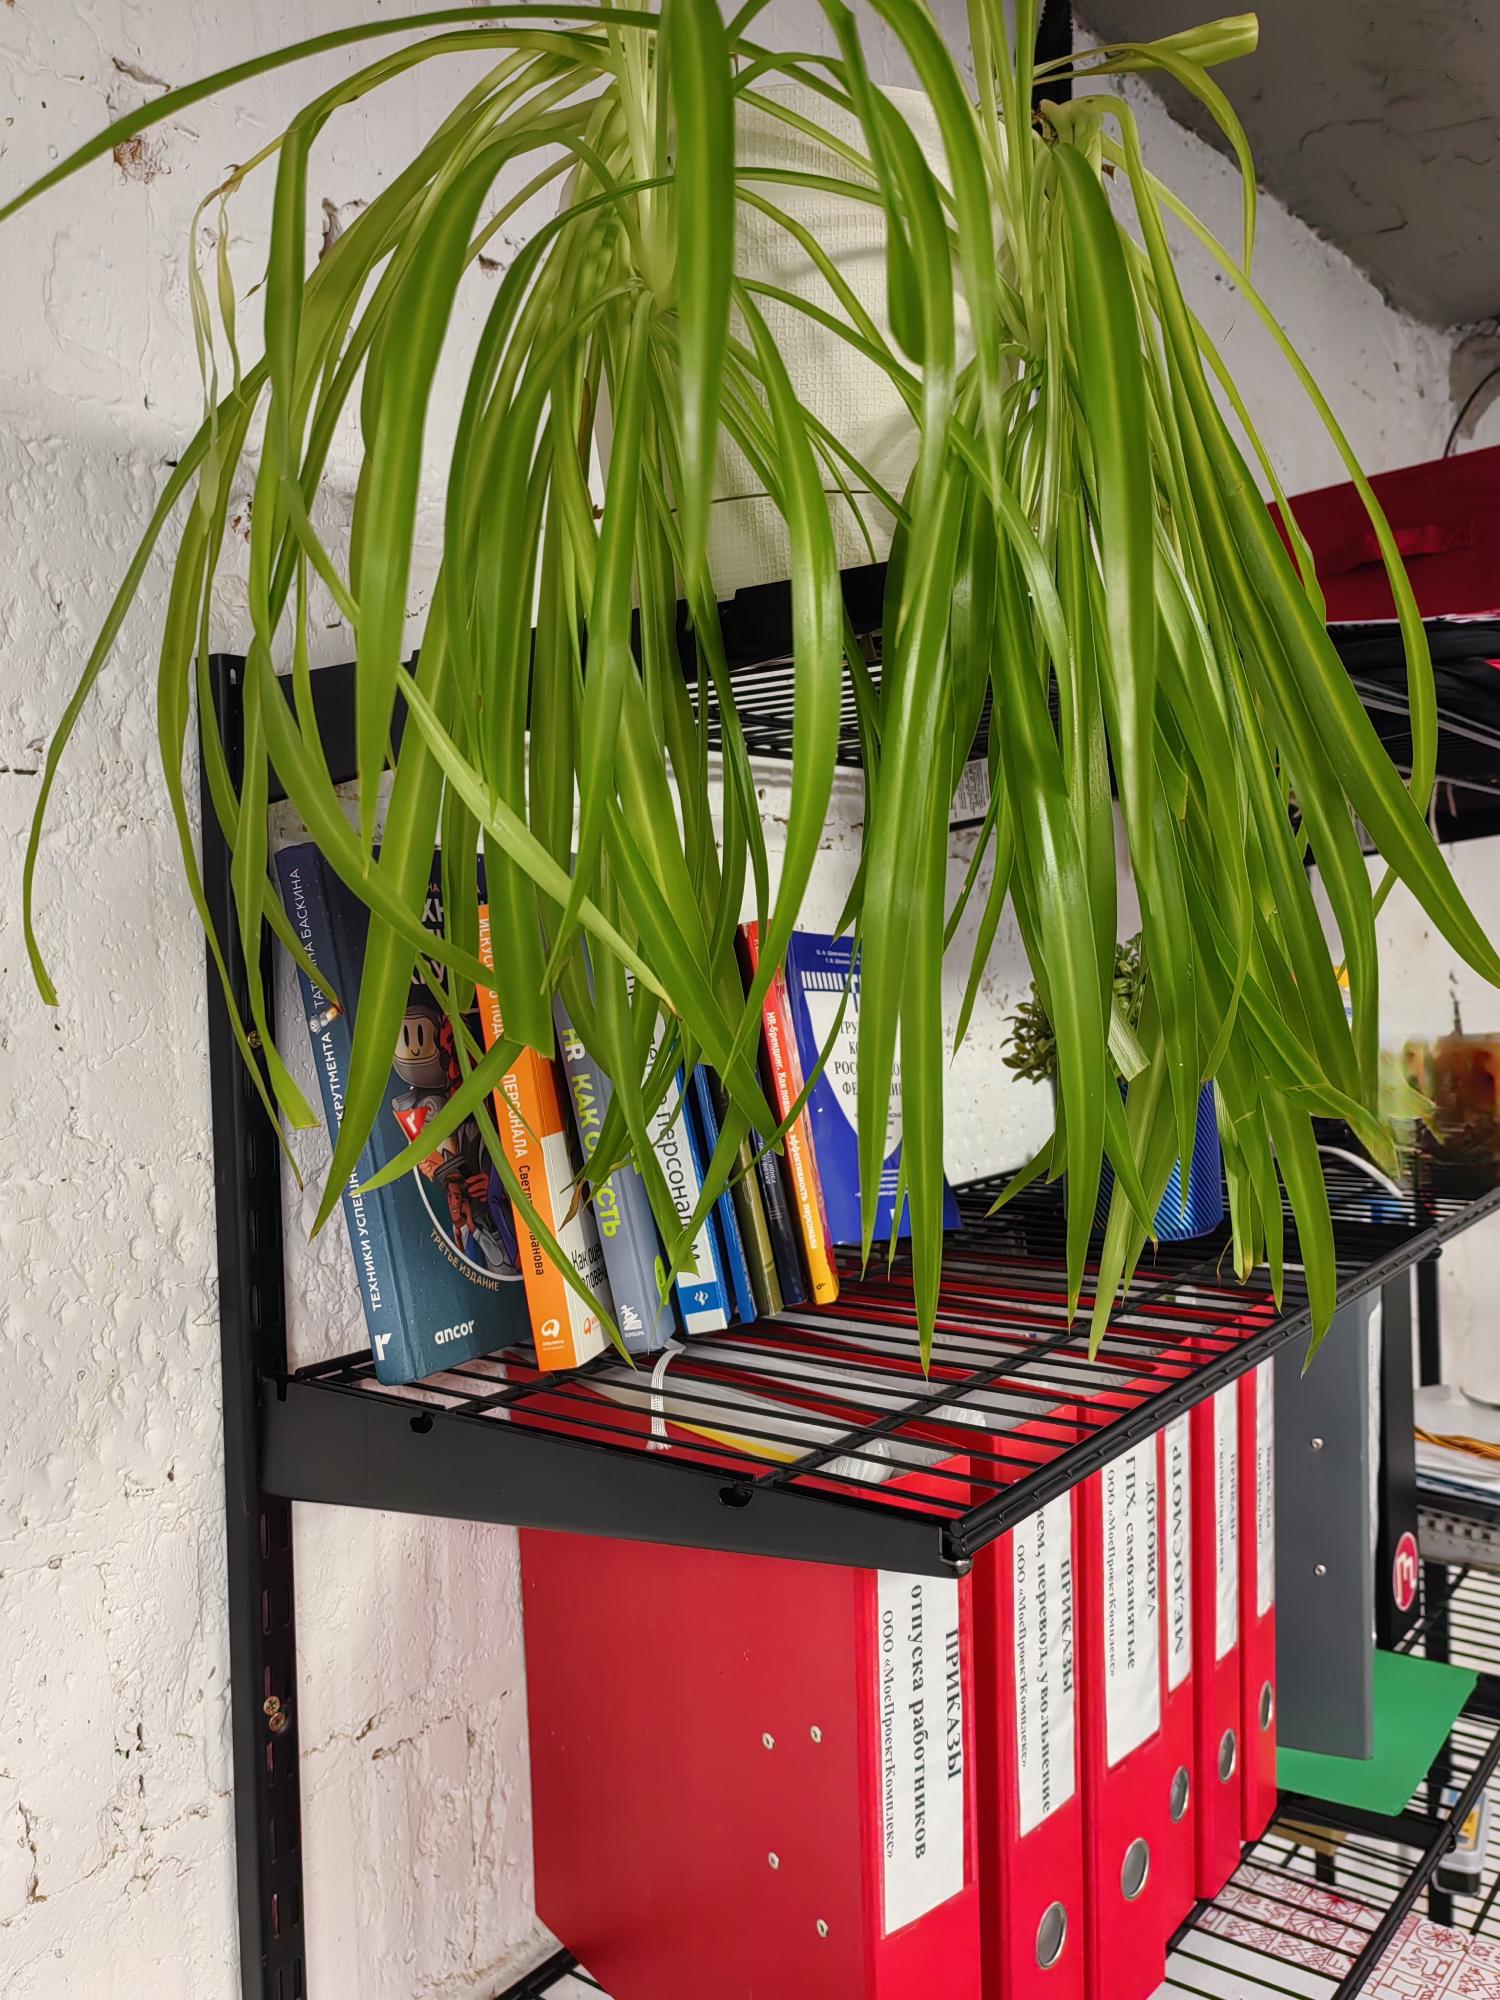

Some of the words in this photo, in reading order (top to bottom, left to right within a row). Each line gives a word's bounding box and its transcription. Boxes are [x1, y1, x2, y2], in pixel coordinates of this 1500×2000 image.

[289, 867, 312, 941] БАСКИНА
[303, 941, 325, 1010] ТАТНА
[321, 1031, 343, 1128] КРУТМЕНТА
[561, 1028, 586, 1062] HR
[501, 1073, 529, 1159] ПЕРСОНАЛА
[571, 1072, 600, 1128] КАК
[596, 1183, 621, 1238] СТЬ
[656, 1110, 701, 1260] персоналм
[789, 1133, 808, 1202] эффективность
[802, 1203, 818, 1249] персонала
[358, 1239, 381, 1312] ТЕХНИКИ
[430, 1228, 459, 1269] ТРЕТЬЕ
[458, 1264, 501, 1292] ИЗДАНИЕ
[528, 1230, 545, 1276] ванова
[434, 1318, 477, 1346] ancor
[1106, 1469, 1116, 1506] ООО
[1125, 1456, 1137, 1517] ГПХ,
[1016, 1544, 1027, 1584] ООО
[1106, 1510, 1118, 1677] «МосПроектКомплекс»
[1172, 1445, 1185, 1655] МЕДОСМОТР
[881, 1609, 895, 1654] ООО
[907, 1583, 925, 1692] отпуска
[1035, 1562, 1049, 1667] перевод,
[1060, 1559, 1074, 1695] ПРИКАЗЫ
[1125, 1522, 1136, 1670] самозанятые
[945, 1628, 964, 1780] ПРИКАЗЫ
[1016, 1588, 1029, 1768] «МосПроектКомплекс»
[880, 1658, 897, 1859] «МосПроектКомплекс»
[908, 1697, 929, 1860] работников
[1036, 1671, 1051, 1815] увольнение
